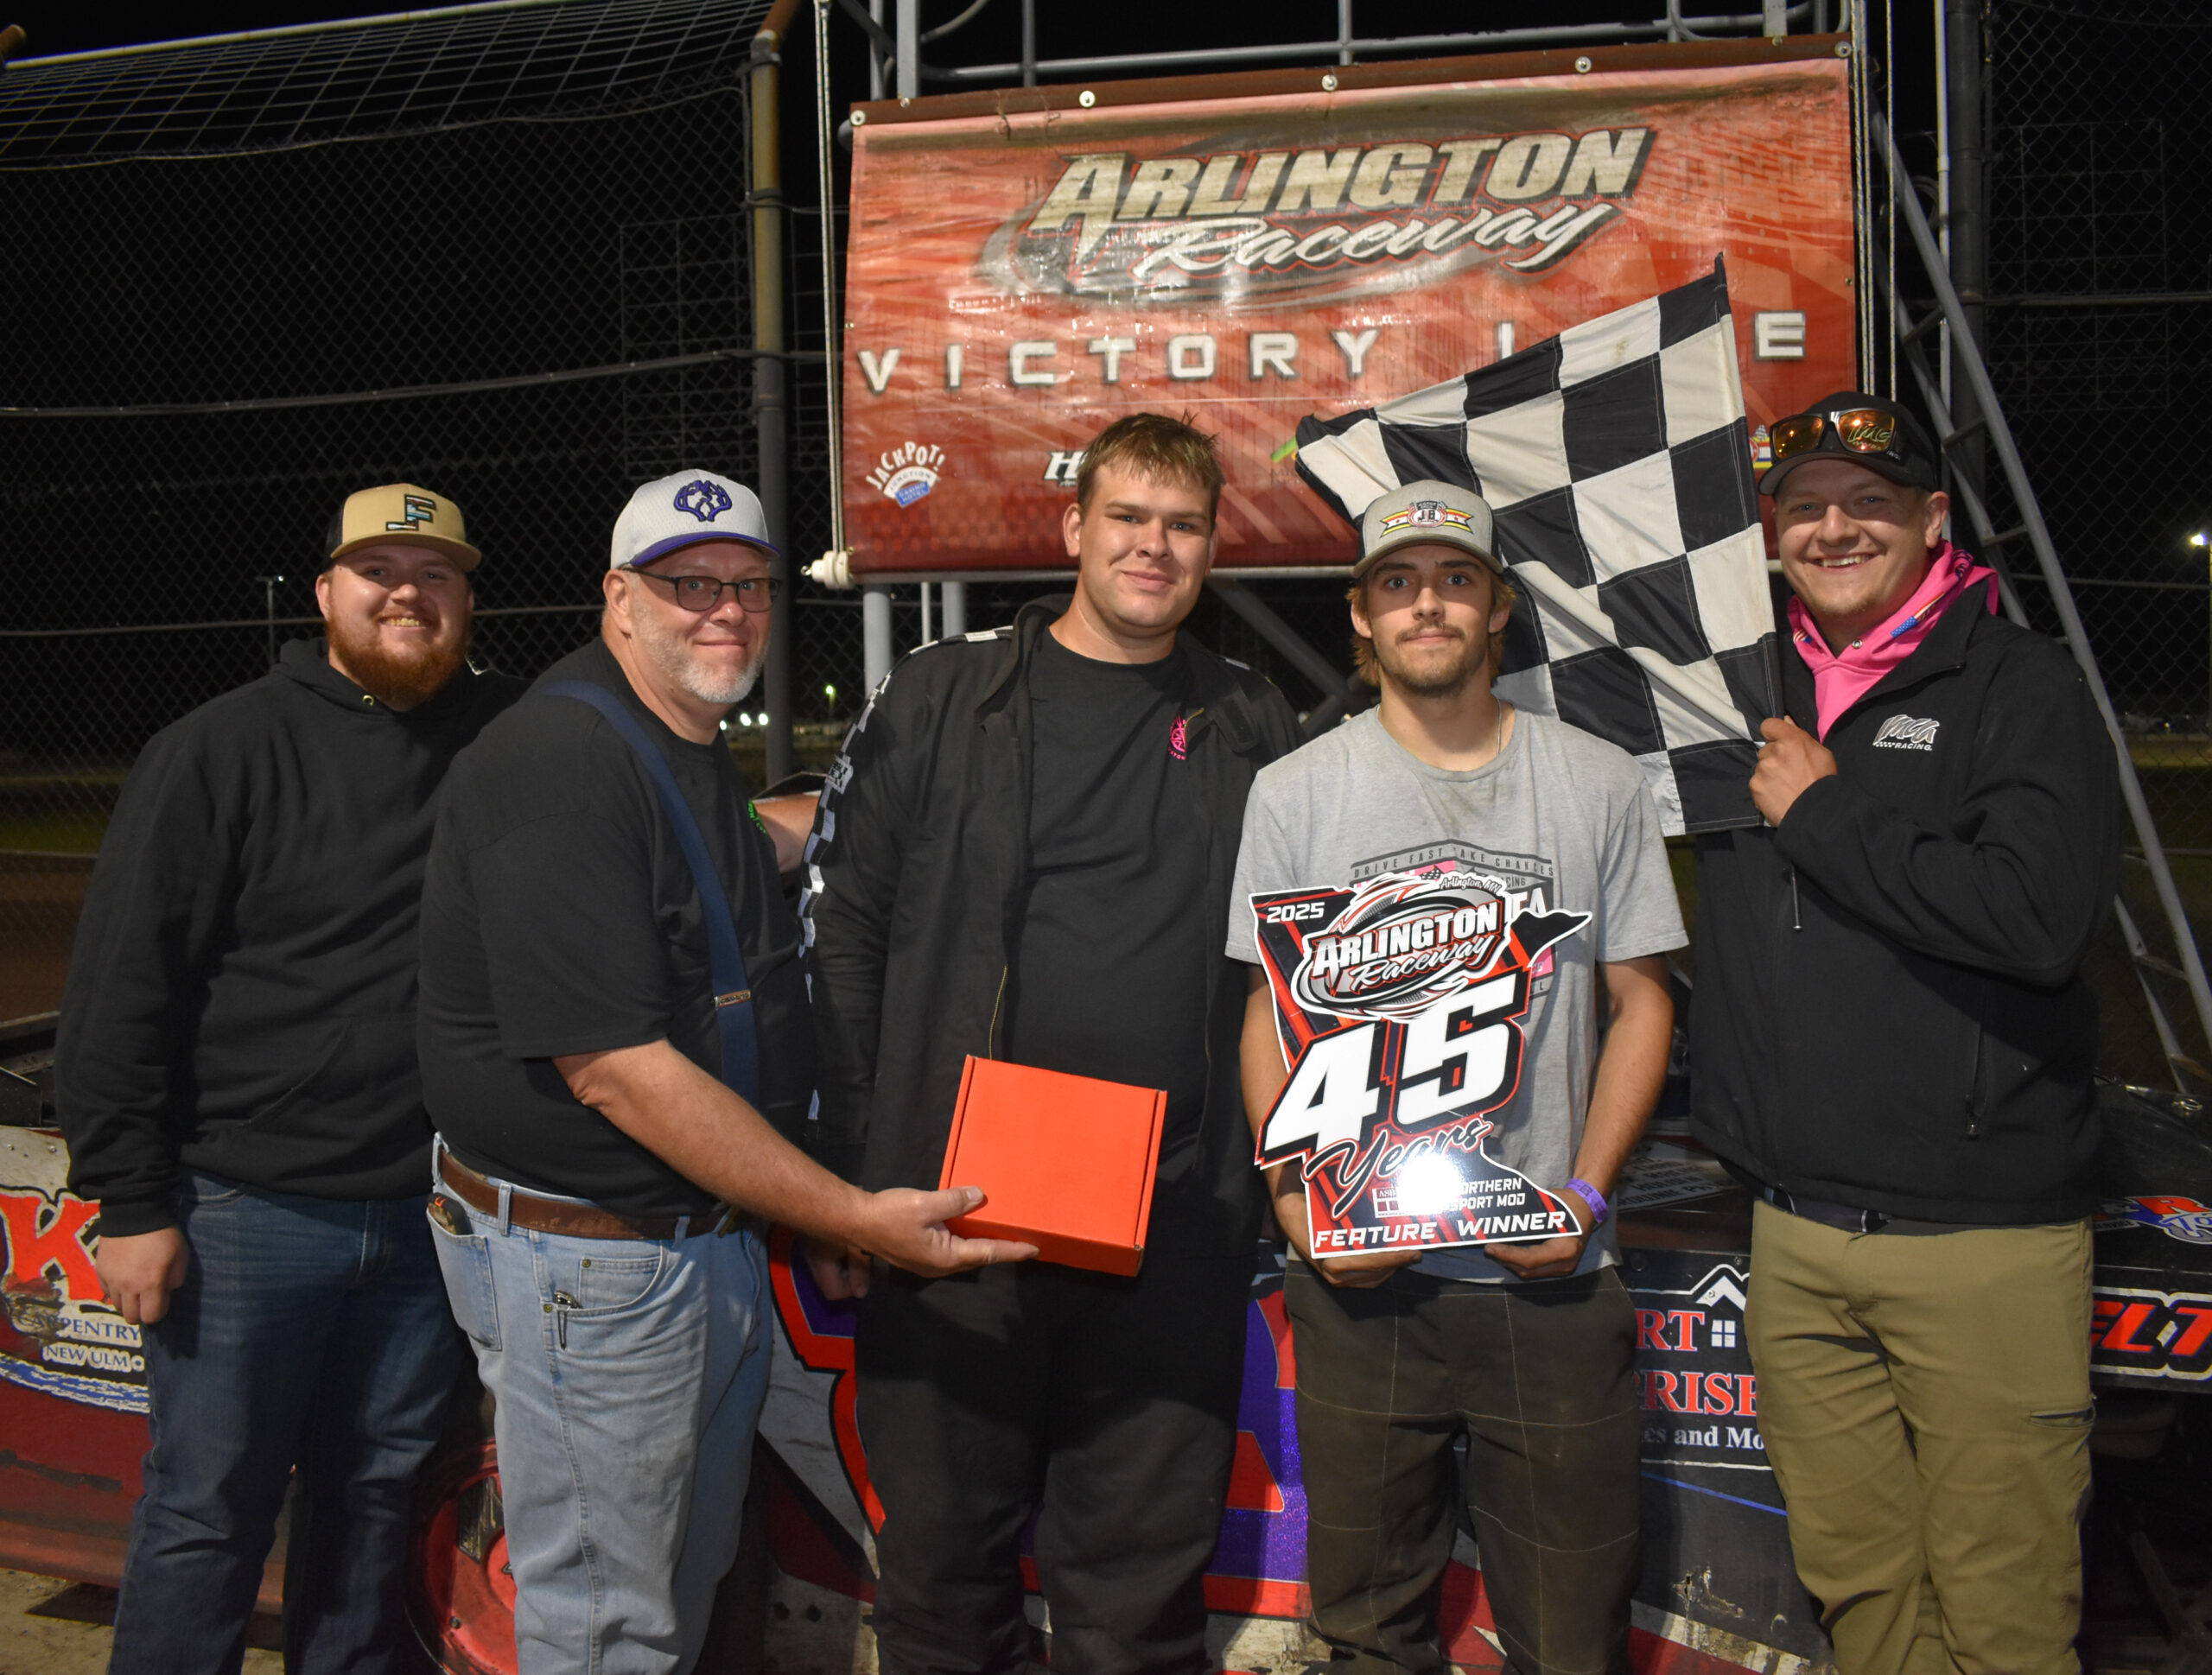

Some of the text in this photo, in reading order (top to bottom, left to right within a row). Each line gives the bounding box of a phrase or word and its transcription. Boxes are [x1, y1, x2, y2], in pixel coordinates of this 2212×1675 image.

[1027, 128, 1649, 263] ARLINGTON
[1133, 204, 1618, 277] Raceway
[857, 329, 1380, 394] VICTORY
[866, 441, 945, 491] JACKPOT!
[1894, 742, 1932, 751] RACING
[1354, 859, 1398, 879] DRIVE
[1409, 849, 1444, 864] FAST
[1495, 857, 1554, 877] CHANCES
[1483, 879, 1502, 894] MN
[1267, 902, 1325, 923] 2025
[1312, 900, 1500, 985] ARLINGTON
[1350, 935, 1496, 990] Raceway
[1264, 976, 1518, 1152] 45
[1304, 1119, 1492, 1219] Years
[1459, 1177, 1522, 1196] ORTHERN
[1497, 1193, 1526, 1208] MOD
[1315, 1212, 1566, 1247] FEATURE WINNER
[1634, 1308, 1705, 1352] RT
[46, 1345, 129, 1367] NEW ULM
[1634, 1370, 1758, 1417] RISE
[1674, 1425, 1719, 1448] and
